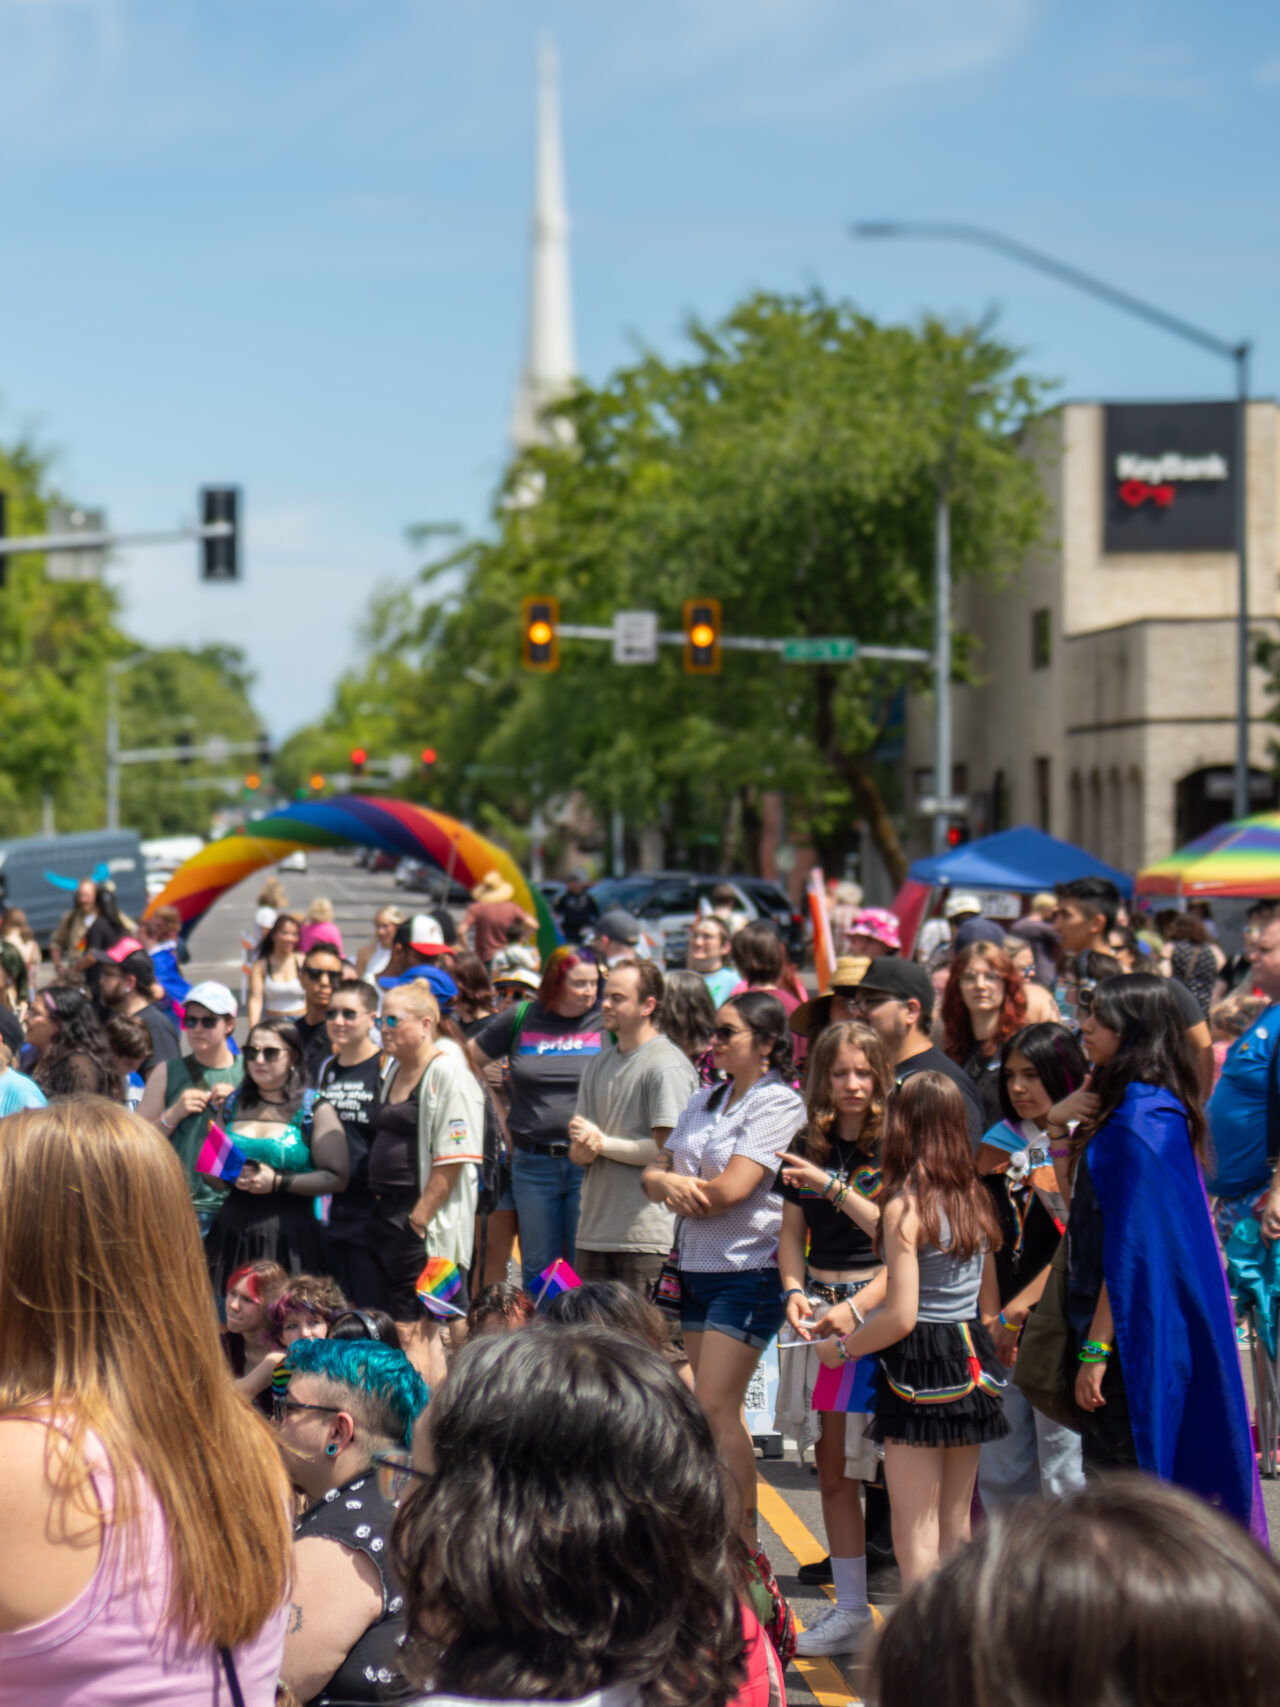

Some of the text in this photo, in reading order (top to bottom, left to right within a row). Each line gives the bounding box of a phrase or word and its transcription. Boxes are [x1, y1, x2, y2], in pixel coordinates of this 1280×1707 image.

[1117, 452, 1227, 484] KeyBank
[537, 1036, 583, 1055] pride
[340, 1112, 356, 1121] on
